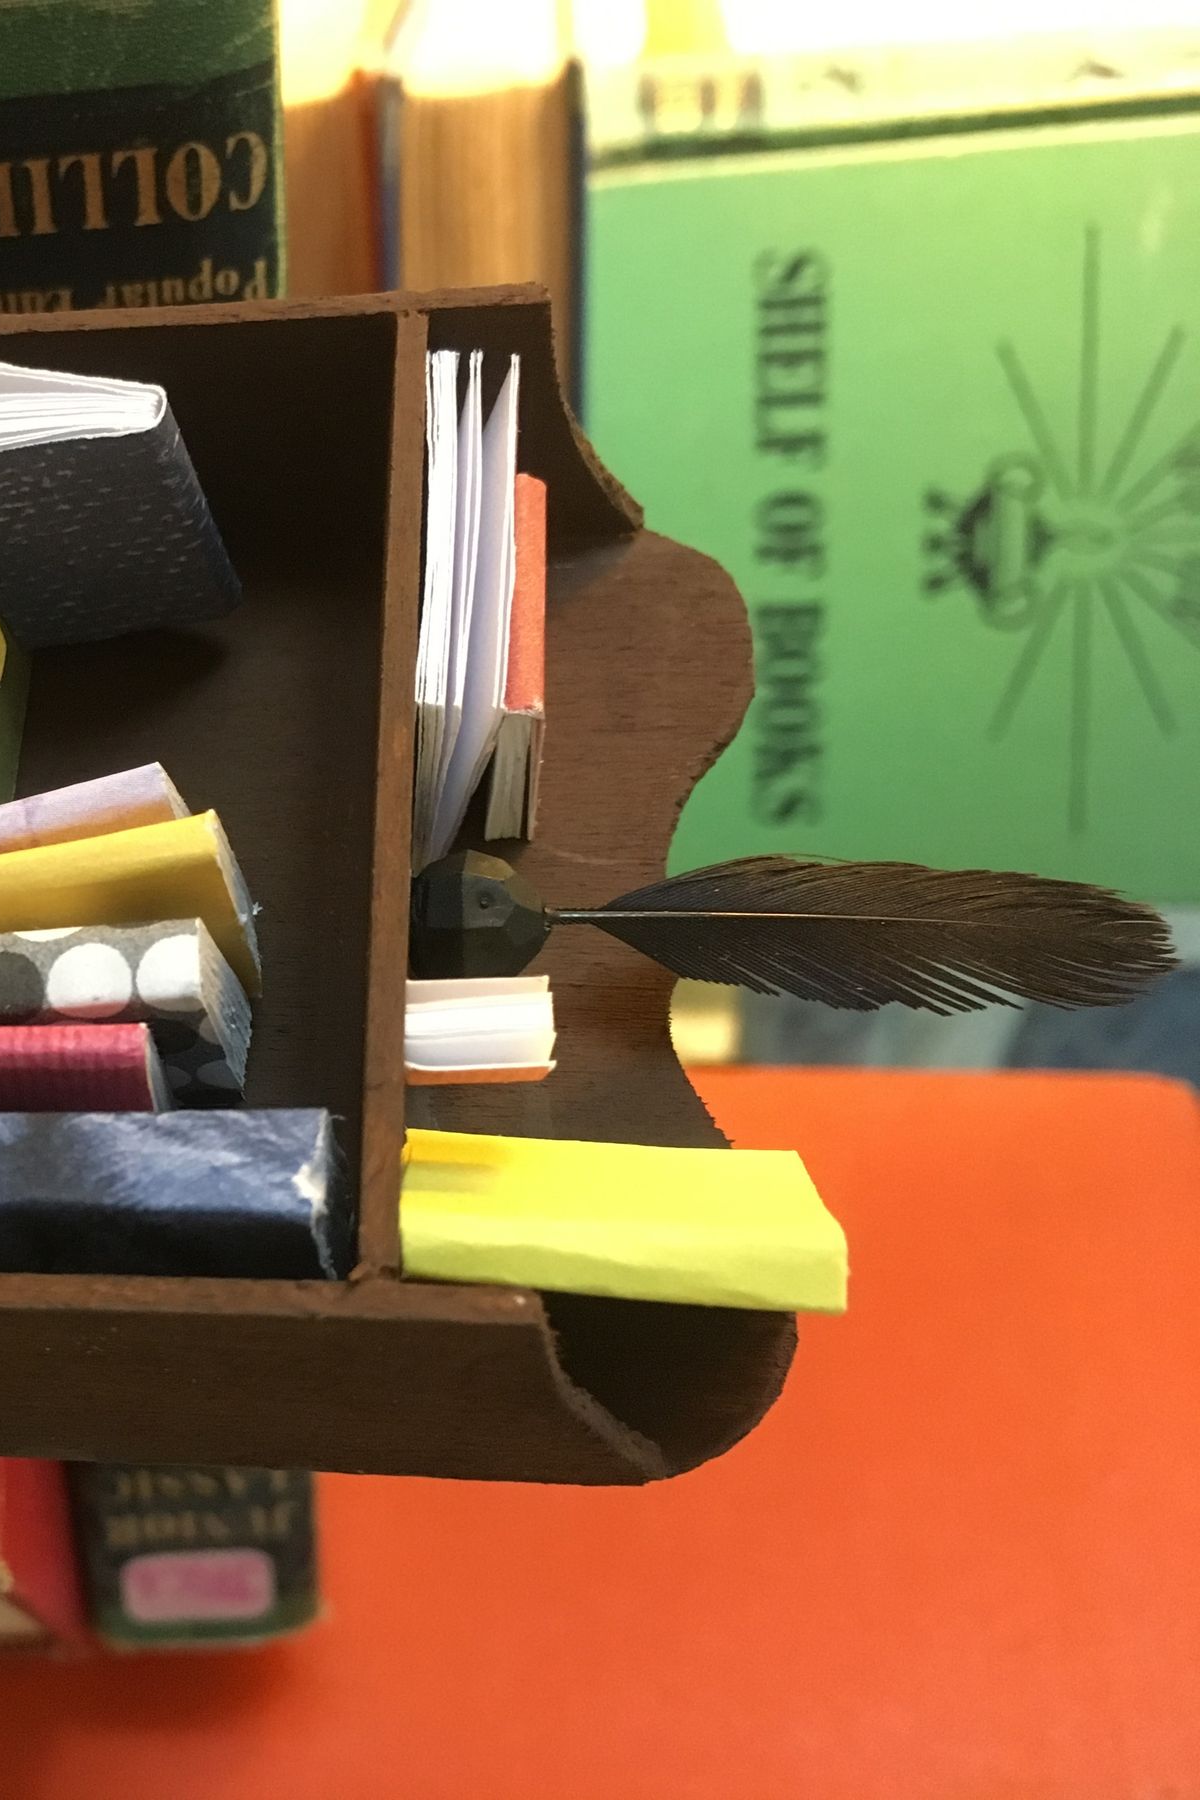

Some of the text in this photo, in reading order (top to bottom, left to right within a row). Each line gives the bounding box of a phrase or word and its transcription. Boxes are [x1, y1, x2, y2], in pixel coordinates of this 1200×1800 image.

[752, 249, 832, 830] SHELF OF BOOKS
